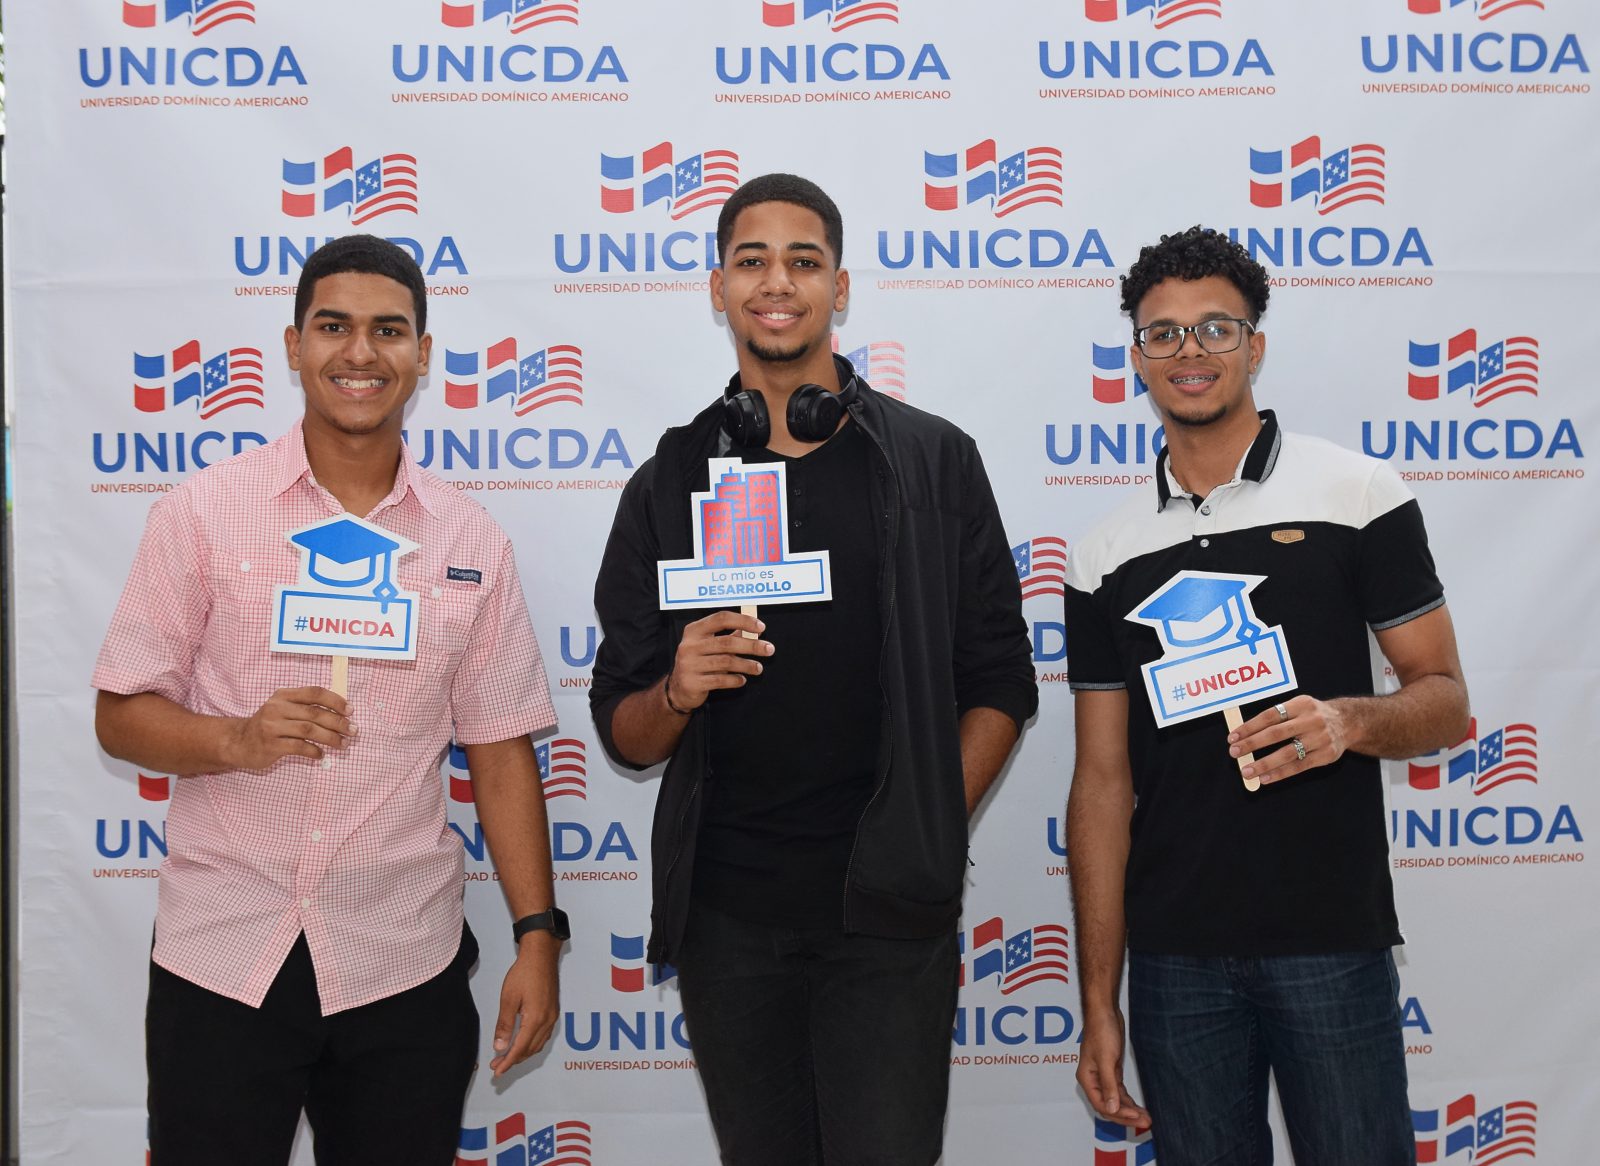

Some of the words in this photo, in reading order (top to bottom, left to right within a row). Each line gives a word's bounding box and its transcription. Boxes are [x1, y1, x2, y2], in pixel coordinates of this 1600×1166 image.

[1039, 39, 1274, 79] UNICDA
[1361, 32, 1589, 73] UNICDA
[79, 47, 307, 88] UNICDA
[392, 45, 628, 83] UNICDA
[716, 43, 950, 84] UNICDA
[1039, 89, 1125, 99] UNIVERSIDAD
[1129, 87, 1195, 98] DOMÍNICO
[1198, 86, 1276, 97] AMERICANO
[1362, 83, 1448, 94] UNIVERSIDAD
[1451, 82, 1514, 94] DOMÍNICO
[1516, 83, 1591, 94] AMERICANO
[80, 96, 160, 108] UNIVERSIDAD
[164, 95, 230, 106] DOMÍNICO
[234, 96, 308, 106] AMERICANO
[392, 93, 478, 103] UNIVERSIDAD
[482, 91, 548, 102] DOMÍNICO
[551, 93, 629, 102] AMERICANO
[715, 93, 801, 103] UNIVERSIDAD
[805, 91, 871, 102] DOMÍNICO
[874, 90, 951, 100] AMERICANO
[554, 231, 721, 273] UNIC
[878, 229, 1114, 270] UNICDA
[1229, 227, 1433, 267] NICDA
[877, 279, 964, 290] UNIVERSIDAD
[968, 277, 1034, 289] DOMÍNICO
[1038, 278, 1115, 288] AMERICANO
[1291, 275, 1356, 287] DOMÍNICO
[1359, 277, 1433, 287] AMERICANO
[554, 283, 640, 294] UNIVERSIDAD
[1046, 423, 1166, 465] UNI
[1362, 419, 1584, 461] UNICDA
[93, 431, 268, 473] UNIC
[1045, 475, 1131, 485] UNIVERSIDAD
[1447, 469, 1510, 480] DOMÍNICO
[1513, 470, 1585, 480] AMERICANO
[91, 483, 174, 493] UNIVERSIDAD
[487, 479, 553, 490] DOMÍNICO
[711, 571, 727, 582] Lo
[760, 569, 774, 580] es
[698, 580, 792, 597] DESARROLLO
[294, 616, 395, 637] #UNICDA
[1172, 661, 1271, 702] #UNICDA
[1448, 854, 1510, 867] DOMÍNICO
[1513, 852, 1585, 864] AMERICANO
[93, 868, 160, 879] UNIVERSID
[562, 871, 638, 882] AMERICANO
[564, 1060, 651, 1071] UNIVERSIDAD
[974, 1053, 1039, 1065] DOMÍNICO
